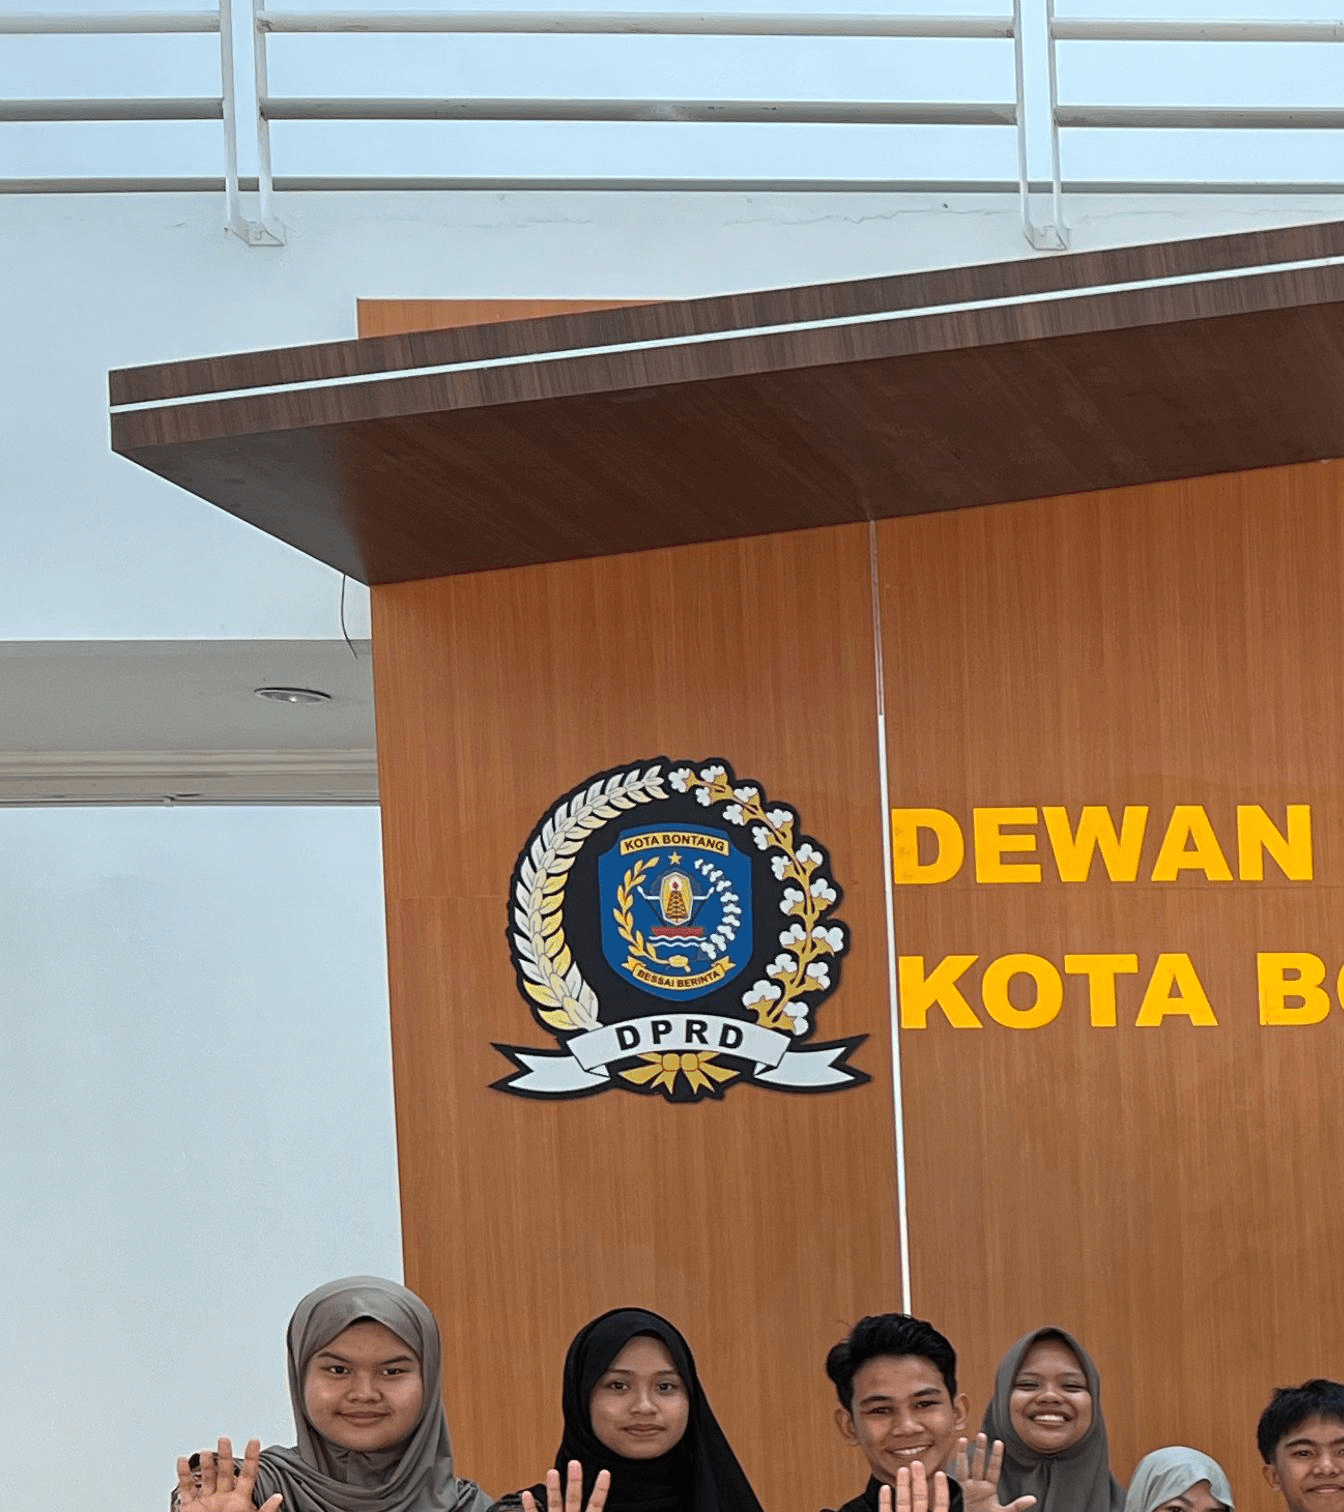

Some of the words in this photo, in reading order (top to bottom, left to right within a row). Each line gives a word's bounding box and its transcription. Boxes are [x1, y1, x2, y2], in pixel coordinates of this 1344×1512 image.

[624, 834, 660, 851] KOTA
[662, 834, 725, 851] BONTANG
[890, 804, 1315, 885] DEWAN
[897, 951, 1218, 1031] KOTA
[615, 1018, 744, 1051] DPRD
